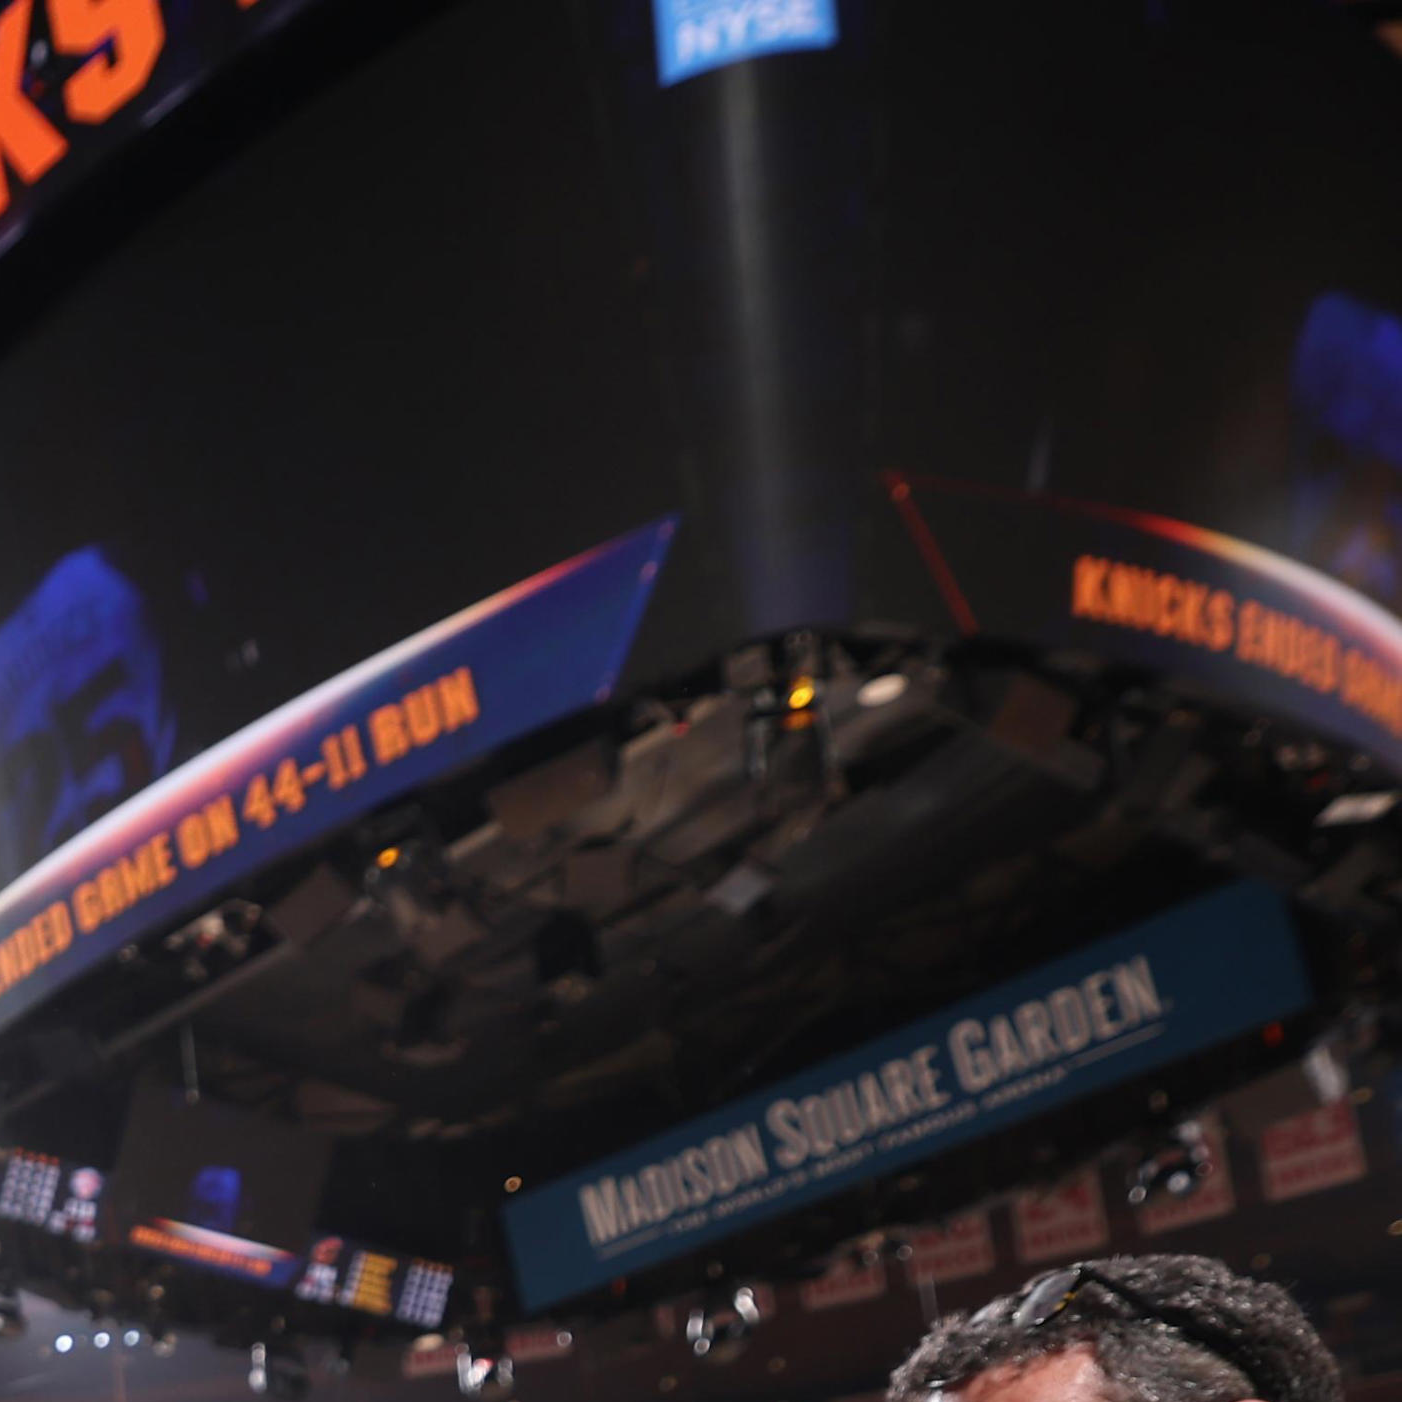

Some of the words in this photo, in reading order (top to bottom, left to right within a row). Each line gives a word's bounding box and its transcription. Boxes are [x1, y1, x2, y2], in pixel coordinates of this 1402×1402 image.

[1071, 555, 1236, 653] KNICKS
[71, 831, 179, 935] GAME
[175, 794, 240, 870] ON
[243, 723, 368, 830] 44-11
[368, 665, 480, 766] RUN
[579, 1122, 769, 1249] MADISON
[765, 1044, 952, 1169] SQUARE
[948, 954, 1163, 1093] GARDEN
